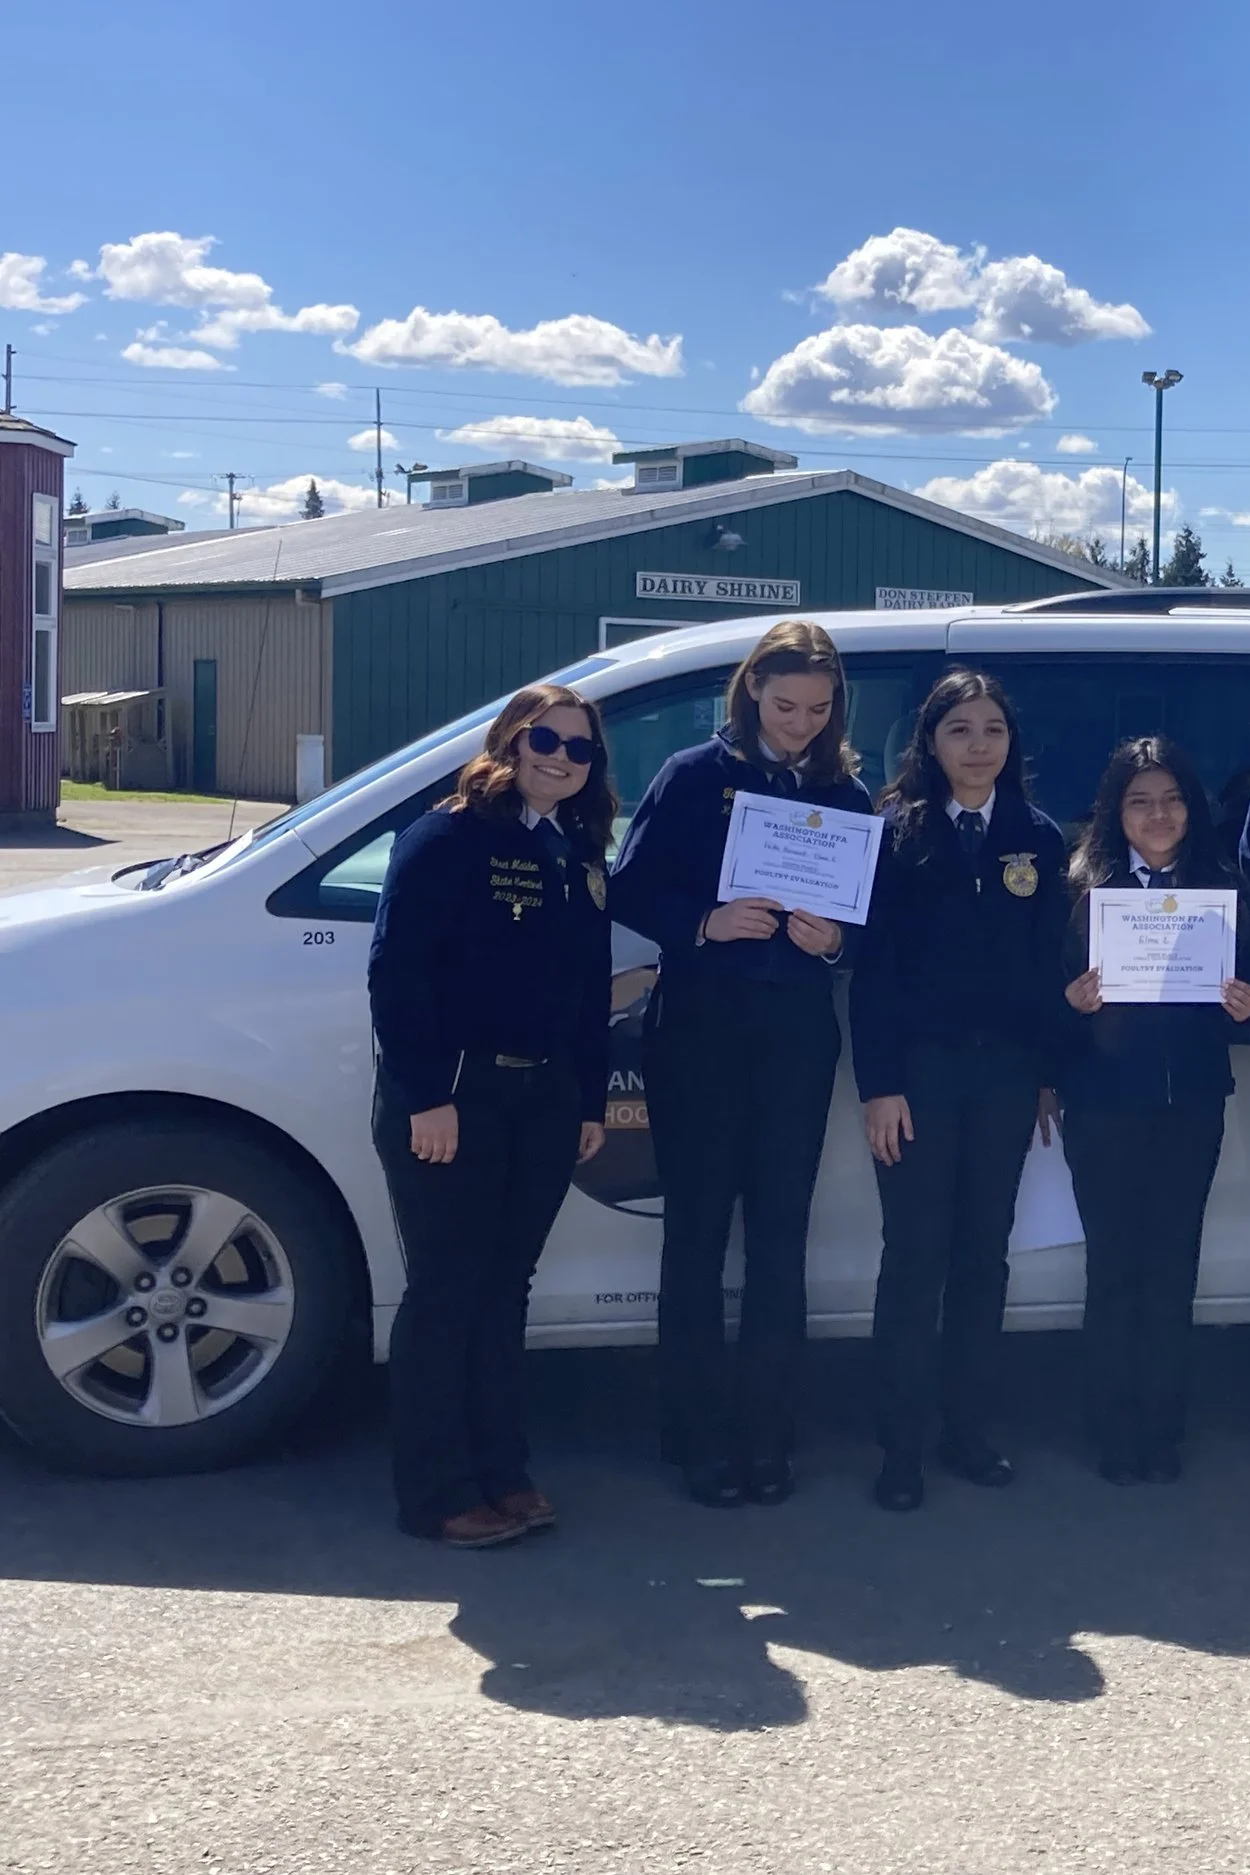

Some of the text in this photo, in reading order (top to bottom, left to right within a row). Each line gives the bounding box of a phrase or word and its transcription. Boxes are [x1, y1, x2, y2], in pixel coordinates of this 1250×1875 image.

[640, 577, 795, 601] DAIRY SHRINE
[878, 588, 971, 603] DON STEFFEN
[884, 599, 924, 610] DAIRY
[764, 821, 848, 844] WASHINGTON FFA
[772, 831, 836, 849] ASSOCIATION
[754, 869, 789, 881] POULTRY
[790, 874, 840, 889] EVALUATION
[1121, 915, 1205, 923] WASHINGTON FFA
[1132, 923, 1194, 931] ASSOCIATION
[303, 931, 335, 945] 203
[595, 1292, 623, 1304] FOR
